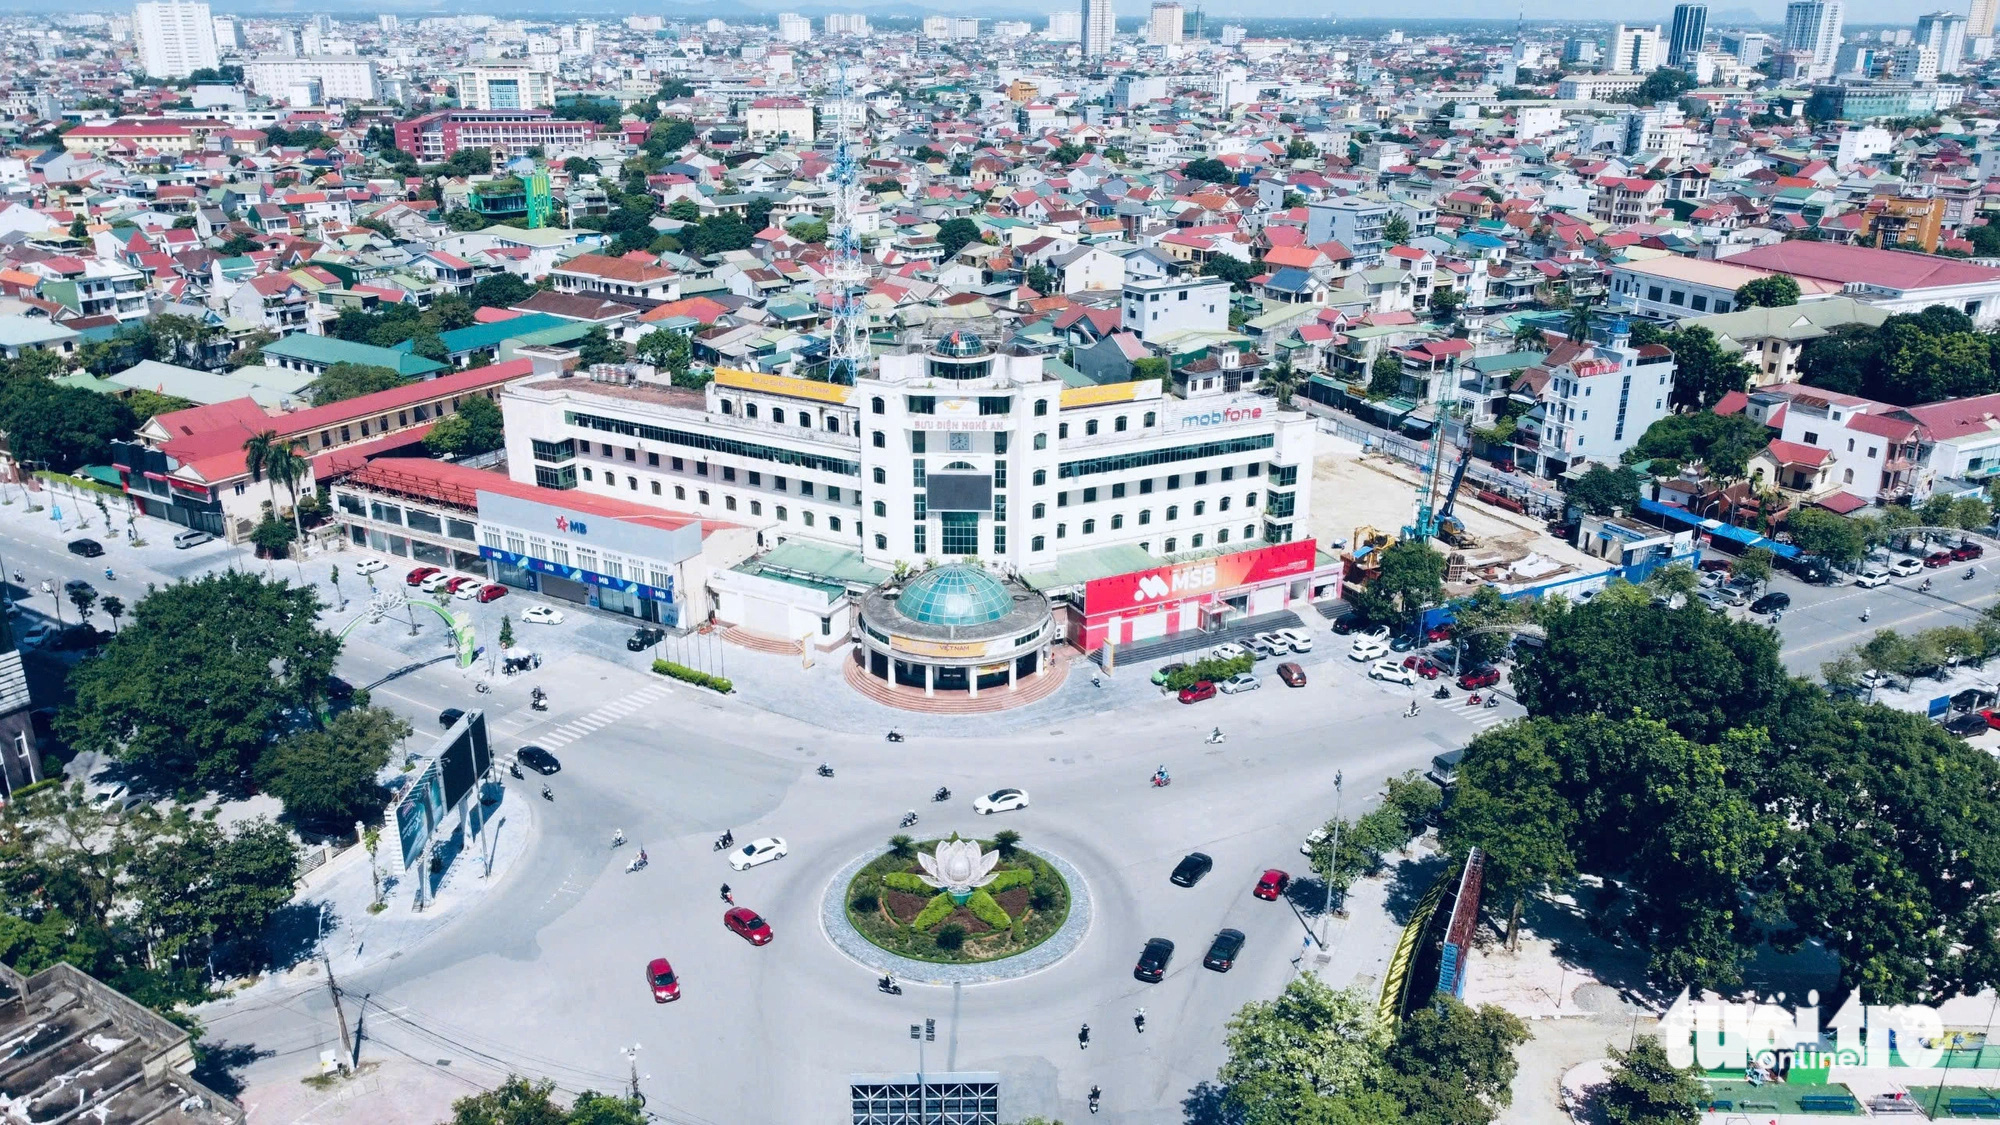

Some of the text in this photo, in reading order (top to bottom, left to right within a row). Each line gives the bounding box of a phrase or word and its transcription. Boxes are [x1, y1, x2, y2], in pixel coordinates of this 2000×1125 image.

[1182, 407, 1262, 429] mobifone
[990, 421, 1004, 430] AN
[569, 520, 587, 535] MB
[492, 551, 503, 559] MB
[544, 563, 555, 572] MB
[598, 576, 609, 585] MB
[1172, 567, 1216, 591] MSB
[655, 590, 666, 599] MB
